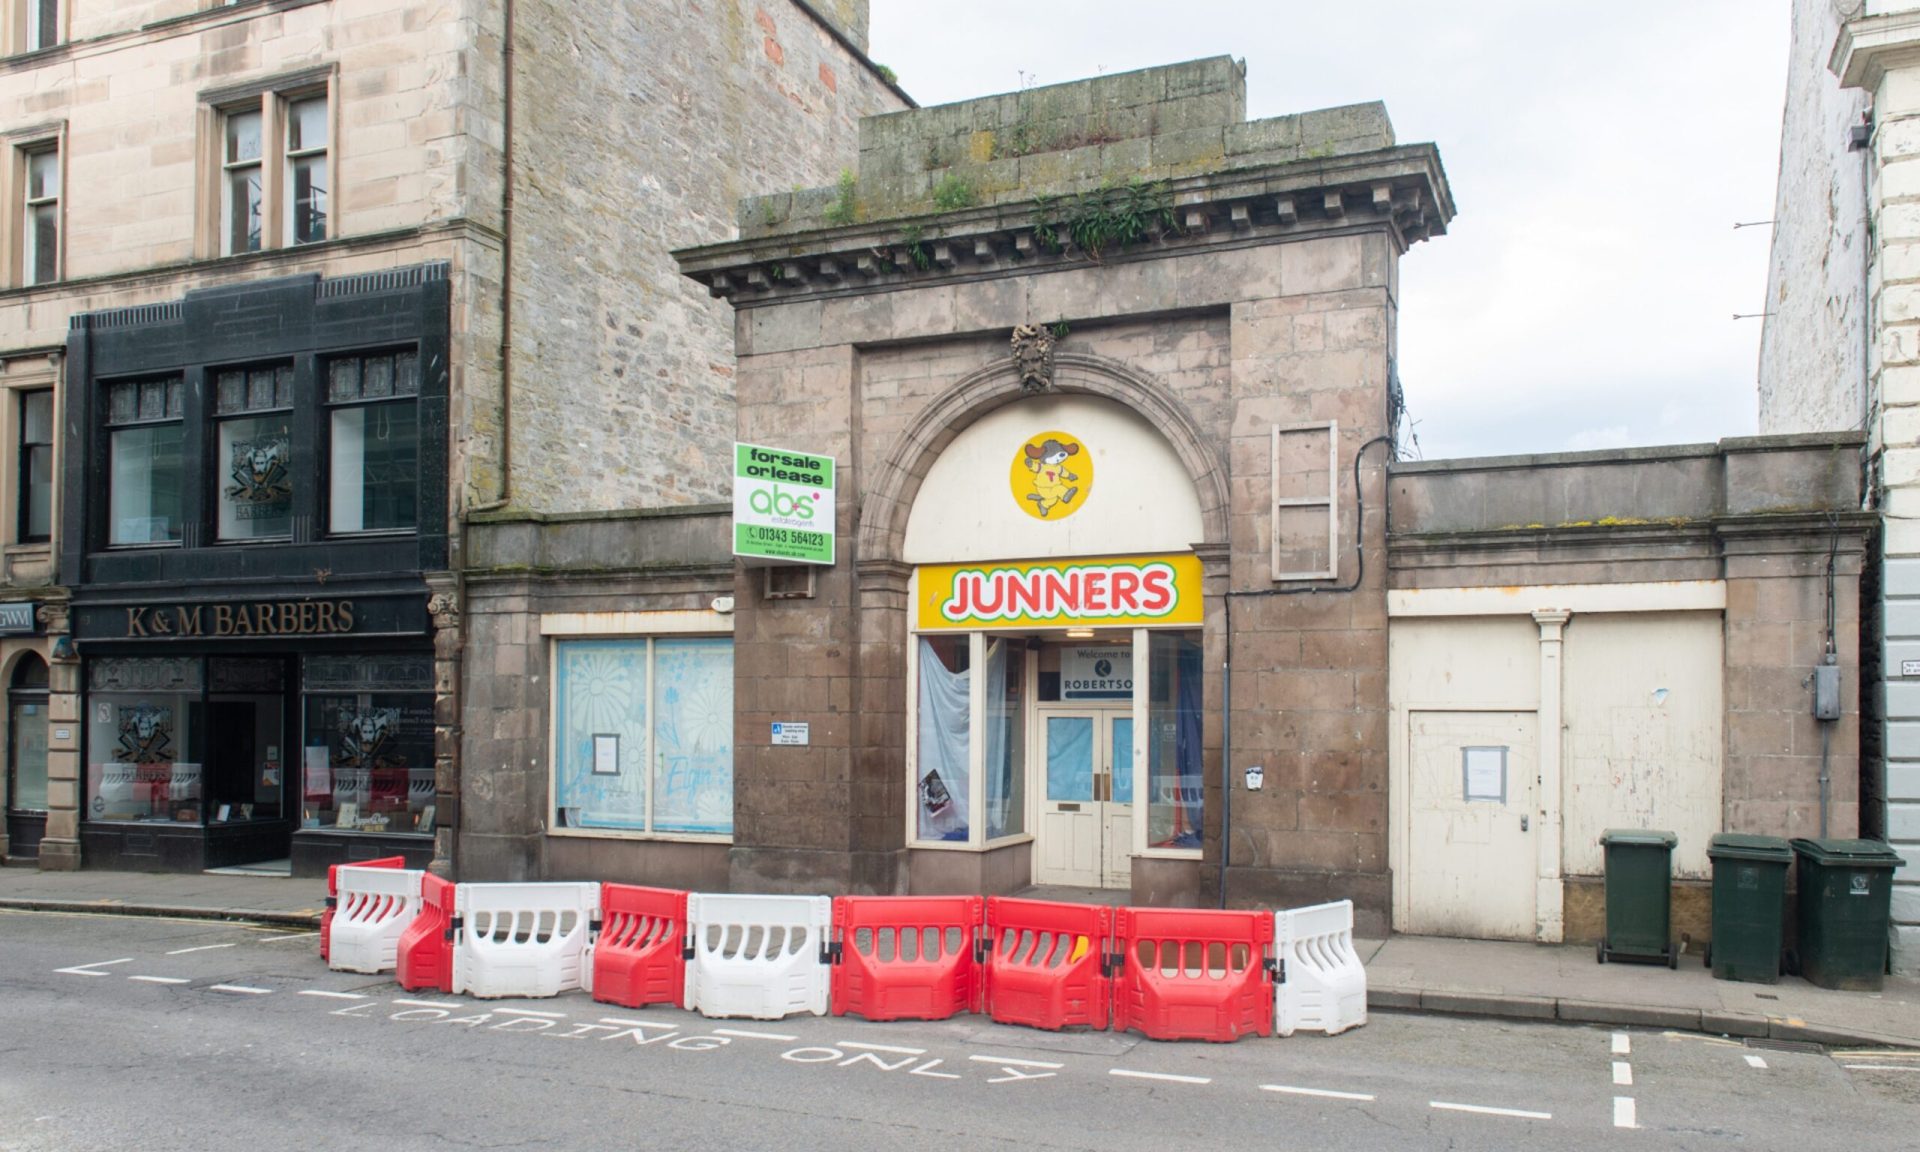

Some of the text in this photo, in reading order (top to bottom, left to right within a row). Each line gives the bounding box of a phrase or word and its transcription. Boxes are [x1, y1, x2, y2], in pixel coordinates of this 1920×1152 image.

[758, 528, 787, 542] 01343
[791, 531, 824, 546] 564123
[948, 570, 1171, 615] JUNNERS
[126, 600, 354, 636] K & M BARBERS
[1077, 649, 1131, 659] Welcome to
[328, 1003, 1057, 1083] LOADING ONLY
